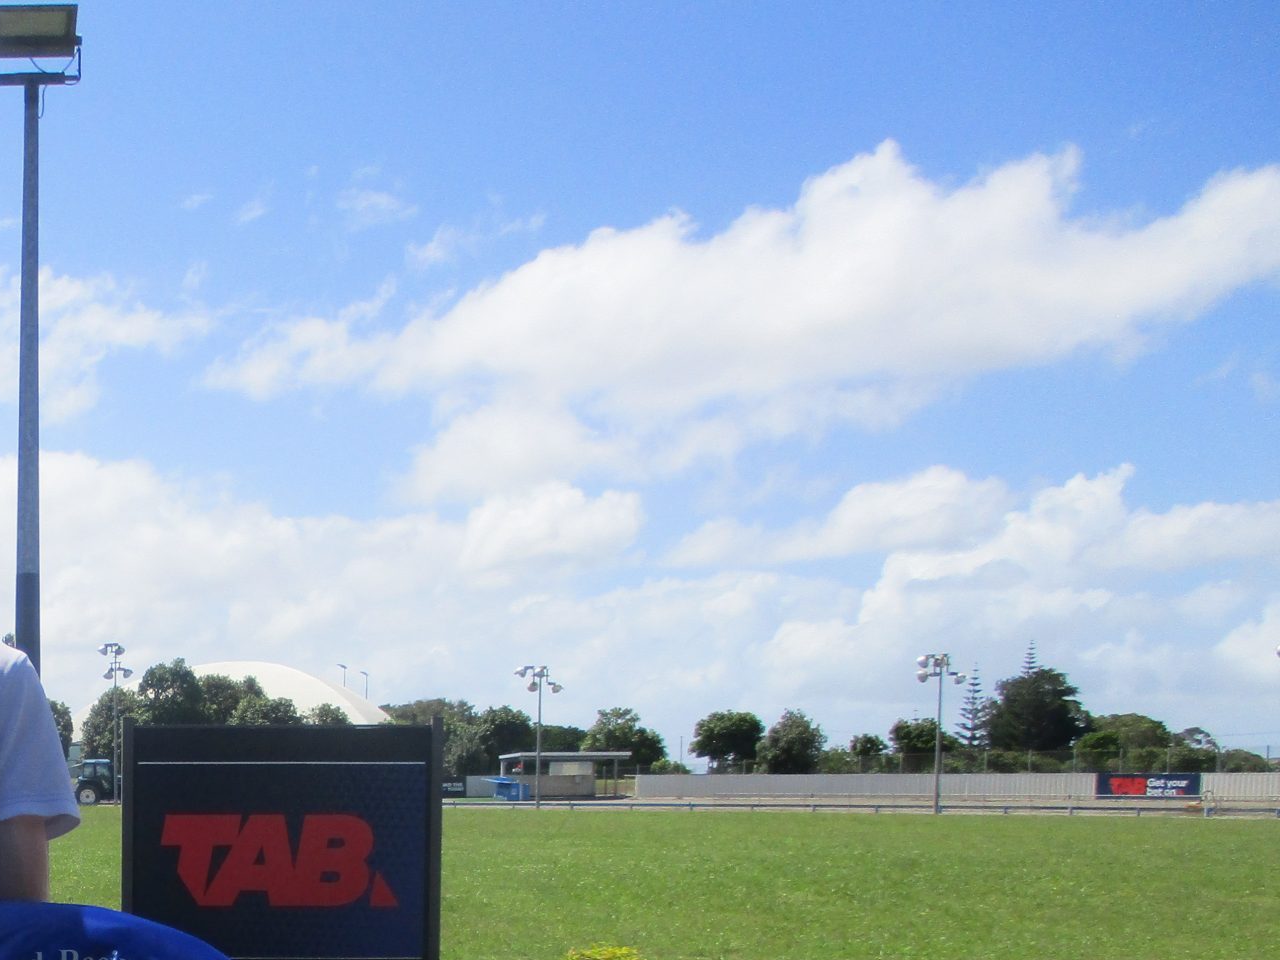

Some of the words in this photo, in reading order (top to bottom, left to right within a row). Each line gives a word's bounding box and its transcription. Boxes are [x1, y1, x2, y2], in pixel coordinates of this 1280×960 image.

[1147, 778, 1166, 787] Get
[1167, 779, 1189, 788] your
[160, 813, 374, 907] TAB
